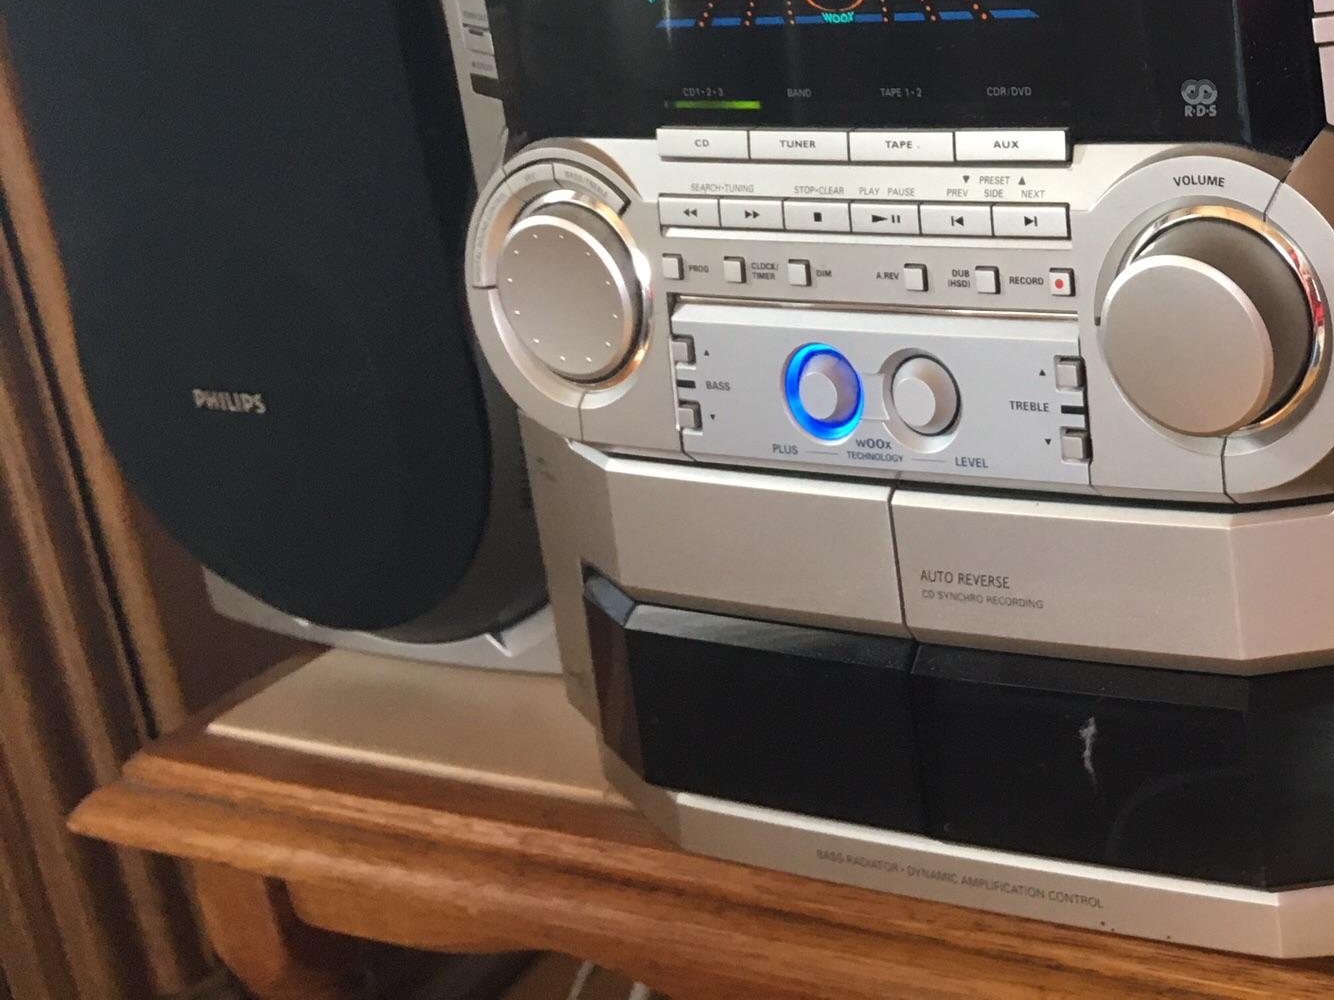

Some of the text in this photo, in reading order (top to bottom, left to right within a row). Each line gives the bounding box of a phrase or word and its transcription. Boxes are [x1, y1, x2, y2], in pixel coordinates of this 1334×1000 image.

[786, 88, 812, 98] BAND
[880, 87, 902, 98] TAPE
[694, 138, 710, 148] CD
[779, 139, 816, 149] TUNER
[885, 140, 913, 149] TAPE
[993, 140, 1020, 150] AUX
[979, 175, 1010, 185] PRESET
[1172, 174, 1226, 188] VOLUME
[859, 186, 915, 197] PLAY PAUSE
[946, 187, 969, 198] PREV
[983, 188, 1004, 199] SIDE
[1021, 189, 1046, 199] NEXT
[689, 264, 709, 274] PROG
[816, 269, 832, 278] DIM
[951, 268, 970, 279] DUB
[752, 271, 776, 281] TIMER
[875, 270, 900, 281] A.REV
[1008, 275, 1045, 286] RECORD
[947, 278, 971, 289] (HSD)
[705, 380, 731, 391] BASS
[192, 387, 266, 414] PHILIPS
[1009, 399, 1049, 413] TREBLE
[772, 443, 799, 455] PLUS
[847, 450, 903, 462] TECHNOLOGY
[955, 456, 989, 469] LEVEL
[920, 569, 1010, 590] AUTO REVERSE
[921, 589, 1044, 609] CD SYNCHRO RECORDING
[846, 854, 898, 872] RADIATOR
[906, 864, 958, 884] DYNAMIC
[961, 874, 1045, 899] AMPLIFICATION
[1048, 889, 1104, 909] CONTROL
